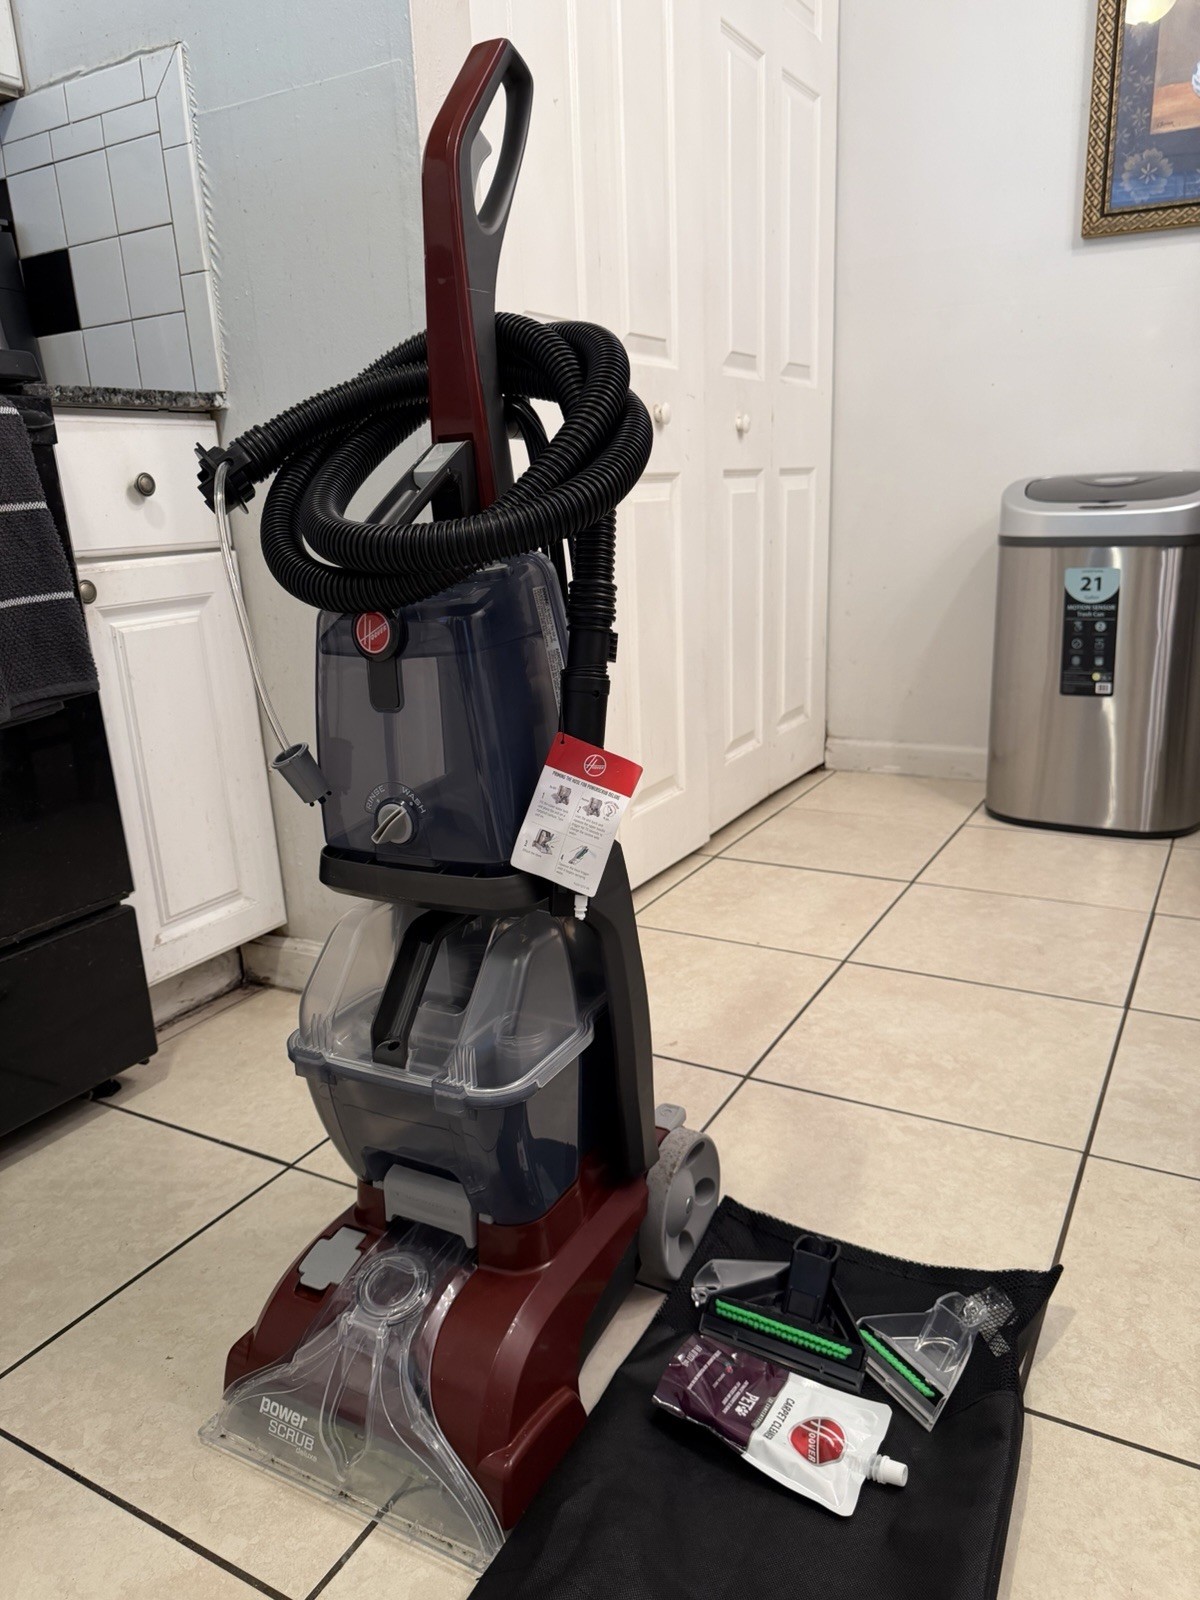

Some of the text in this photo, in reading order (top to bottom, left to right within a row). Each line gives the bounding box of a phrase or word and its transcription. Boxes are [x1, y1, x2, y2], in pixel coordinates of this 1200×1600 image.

[1080, 576, 1102, 592] 21
[366, 784, 386, 810] RINSE
[401, 786, 427, 814] WASH
[259, 1396, 308, 1429] power
[738, 1391, 760, 1412] PET
[777, 1397, 795, 1423] CARPET
[268, 1419, 315, 1451] SCRUB
[295, 1447, 318, 1462] deluxe
